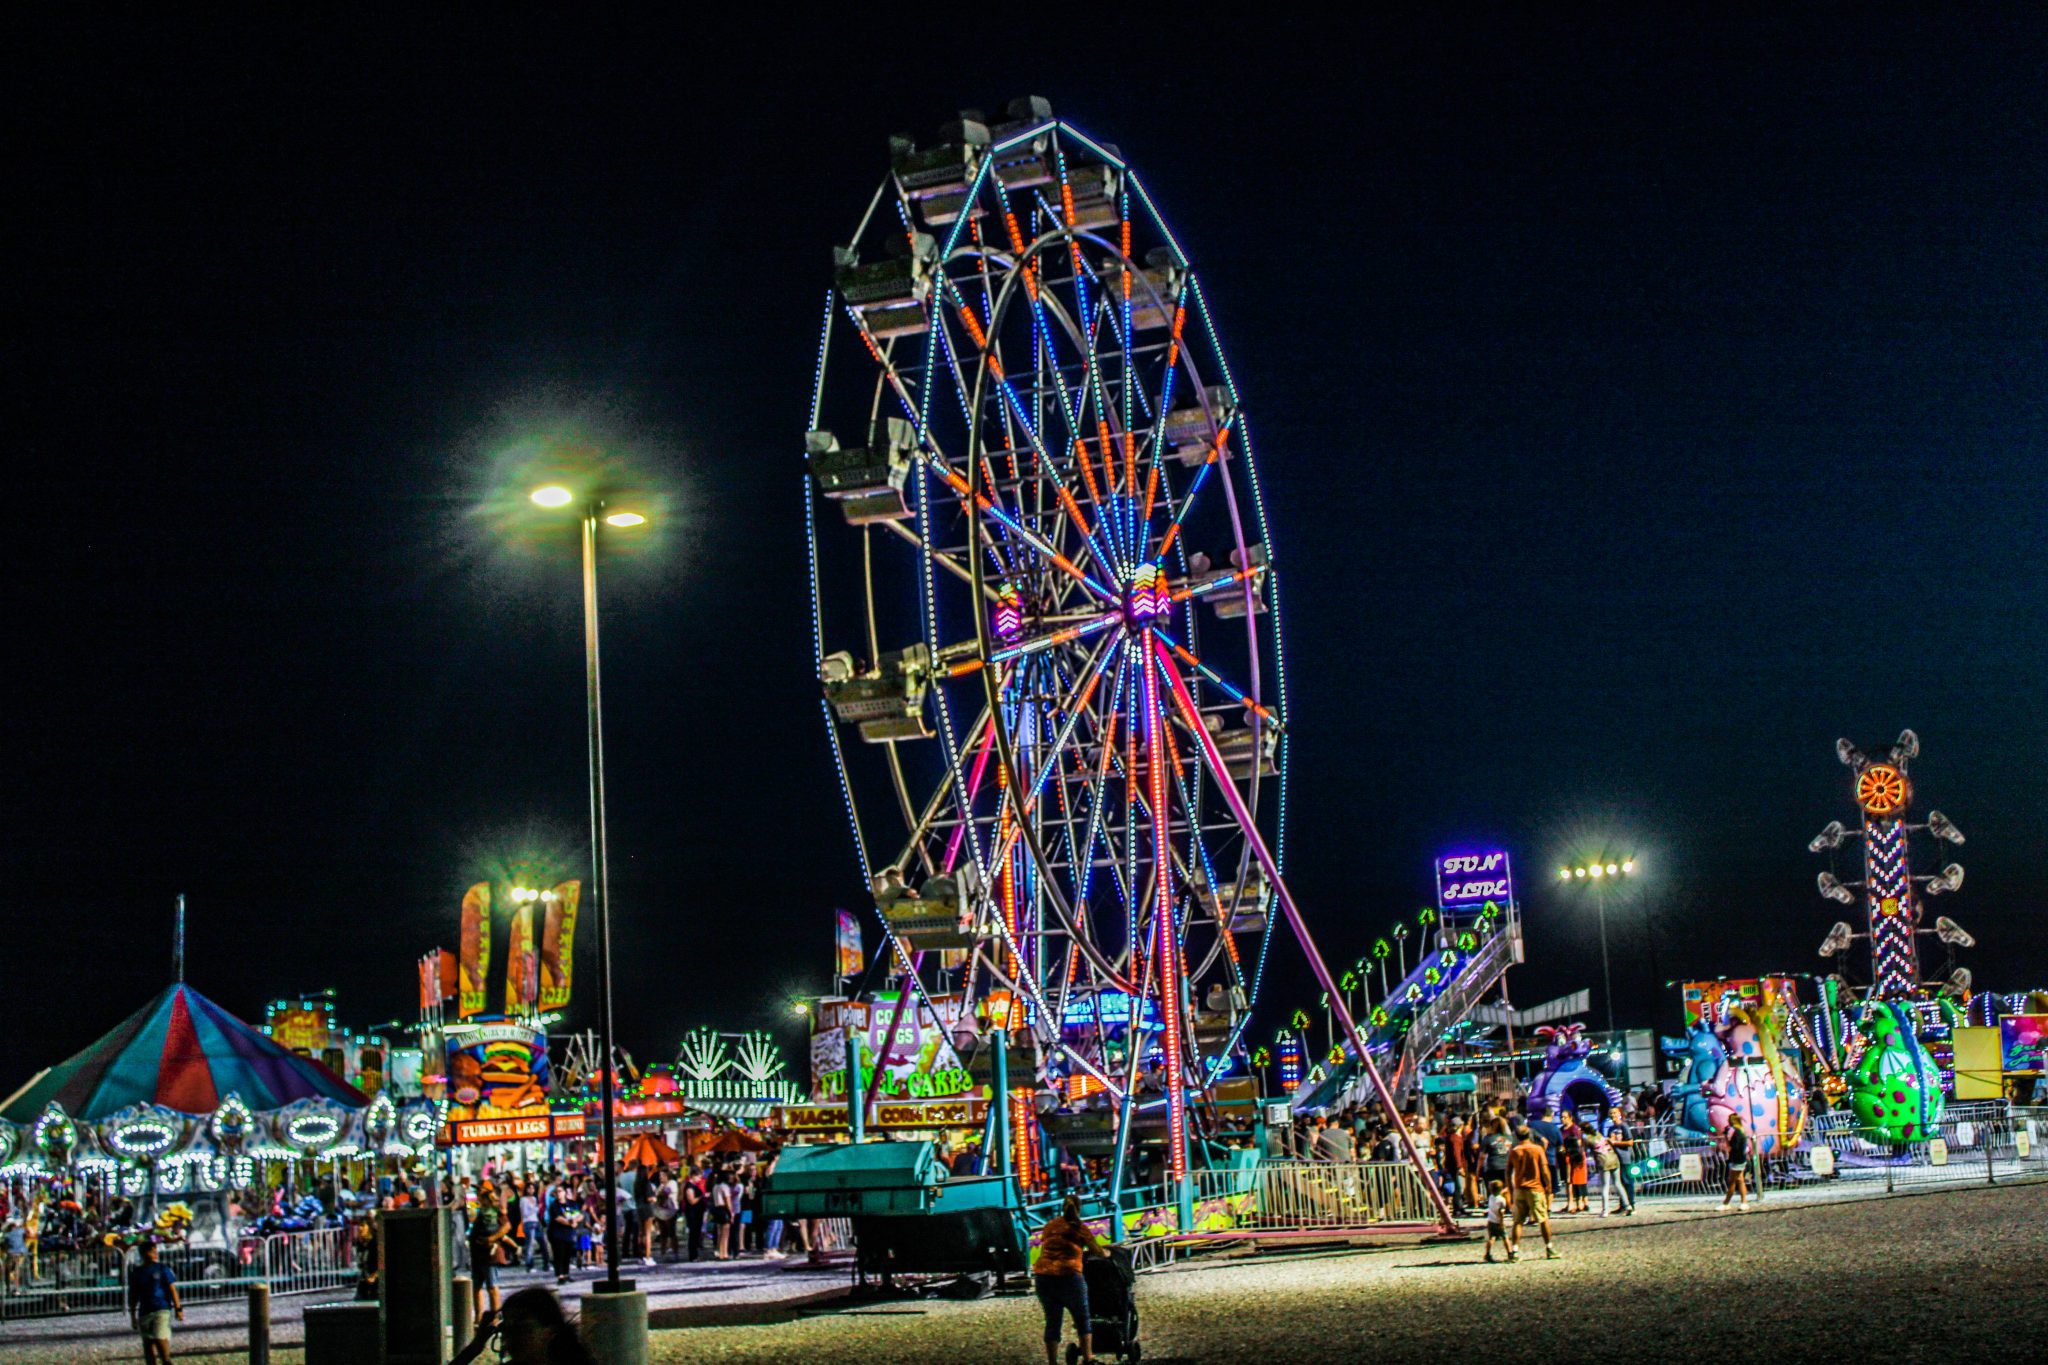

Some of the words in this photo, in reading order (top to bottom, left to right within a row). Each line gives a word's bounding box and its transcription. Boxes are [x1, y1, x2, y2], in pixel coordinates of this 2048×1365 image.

[1443, 853, 1503, 874] FUN
[1443, 880, 1508, 900] SLIDE
[875, 1007, 914, 1026] CON
[876, 1028, 914, 1046] DGS
[820, 1066, 901, 1100] FUNL
[907, 1066, 974, 1098] CAKES
[789, 1109, 848, 1126] NACH
[880, 1106, 923, 1124] CORN
[460, 1122, 514, 1138] TURKEY
[515, 1119, 548, 1134] LEGS
